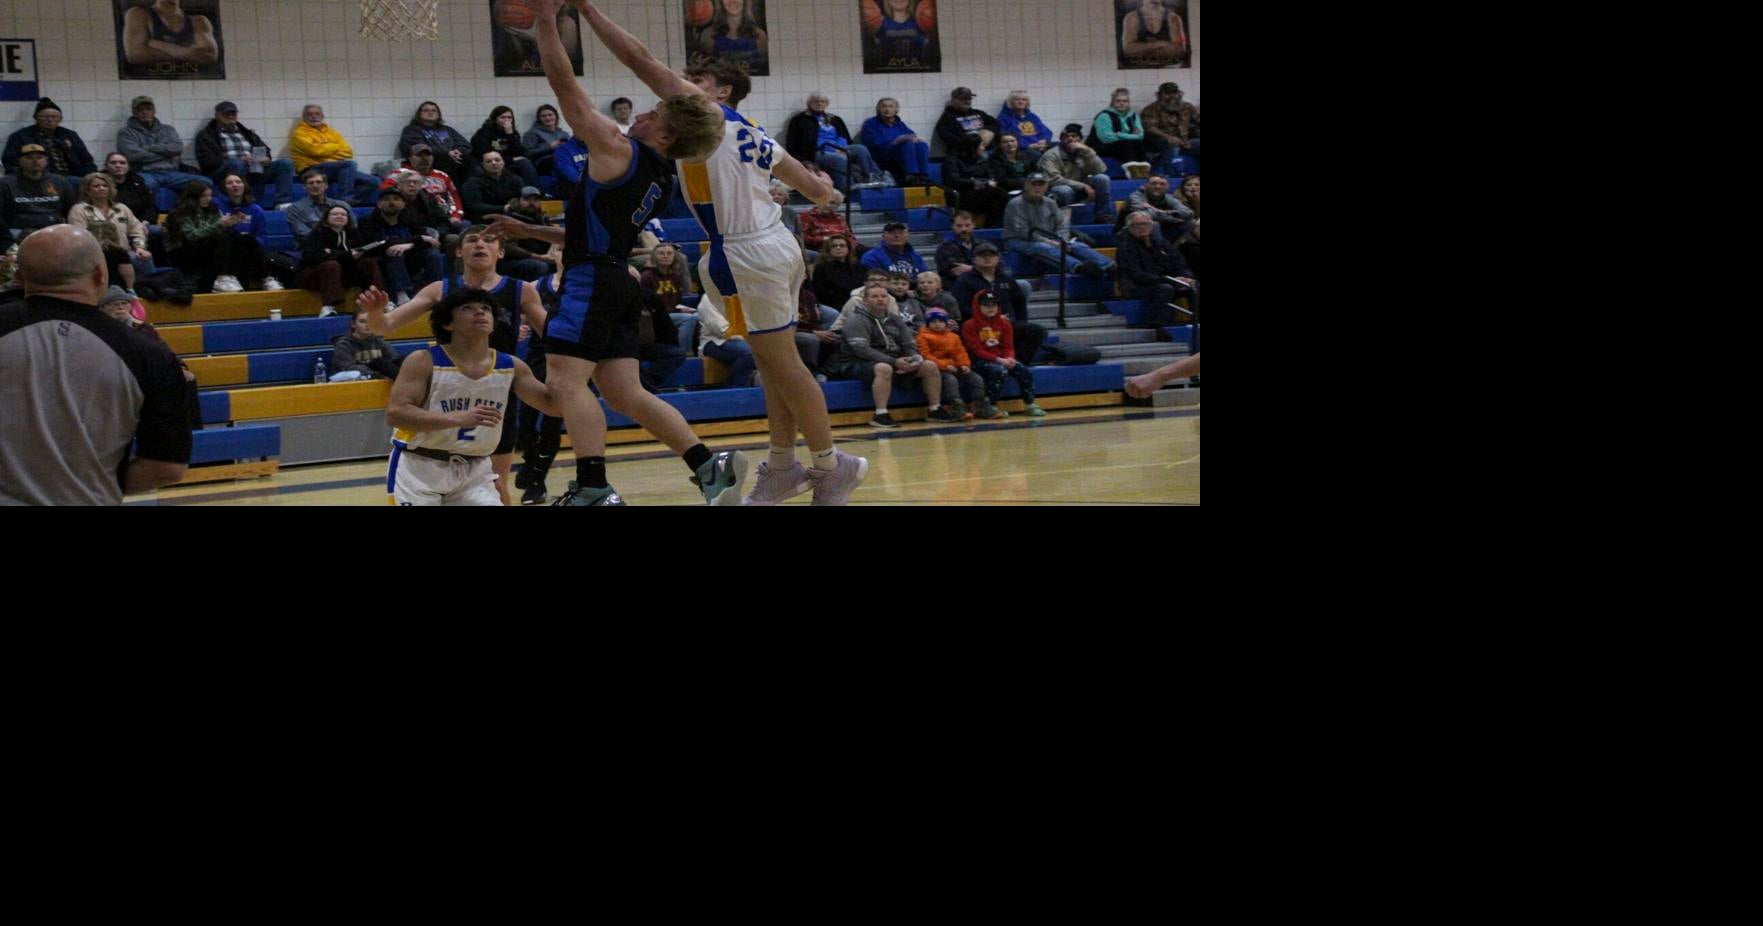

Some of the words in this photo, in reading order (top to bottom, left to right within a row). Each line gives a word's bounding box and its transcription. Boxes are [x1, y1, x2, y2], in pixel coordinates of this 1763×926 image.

[0, 45, 23, 74] E
[149, 61, 199, 74] JOHN
[887, 57, 922, 67] AYLA
[631, 182, 663, 227] 5
[440, 397, 471, 413] RUSH
